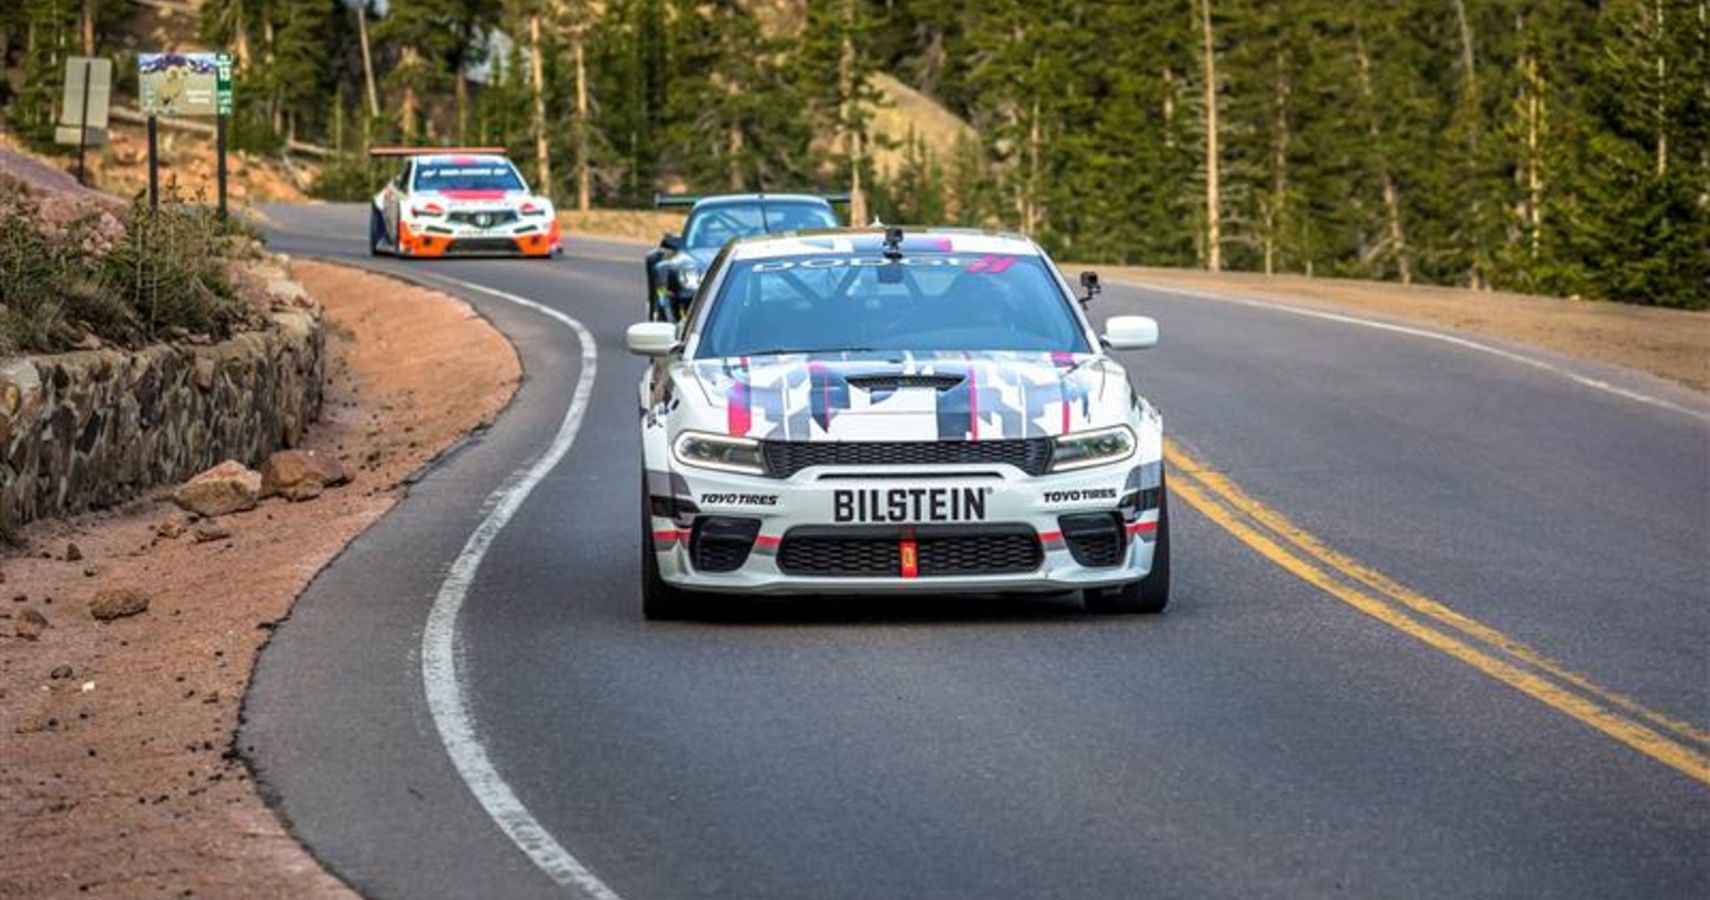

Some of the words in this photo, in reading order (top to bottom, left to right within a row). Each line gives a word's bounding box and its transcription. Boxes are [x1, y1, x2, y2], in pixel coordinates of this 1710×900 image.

[701, 493, 738, 503] TOYO
[739, 493, 779, 505] TIRES
[1043, 491, 1080, 503] TOYO
[1081, 488, 1116, 501] TIRES
[833, 487, 985, 522] BILSTEIN
